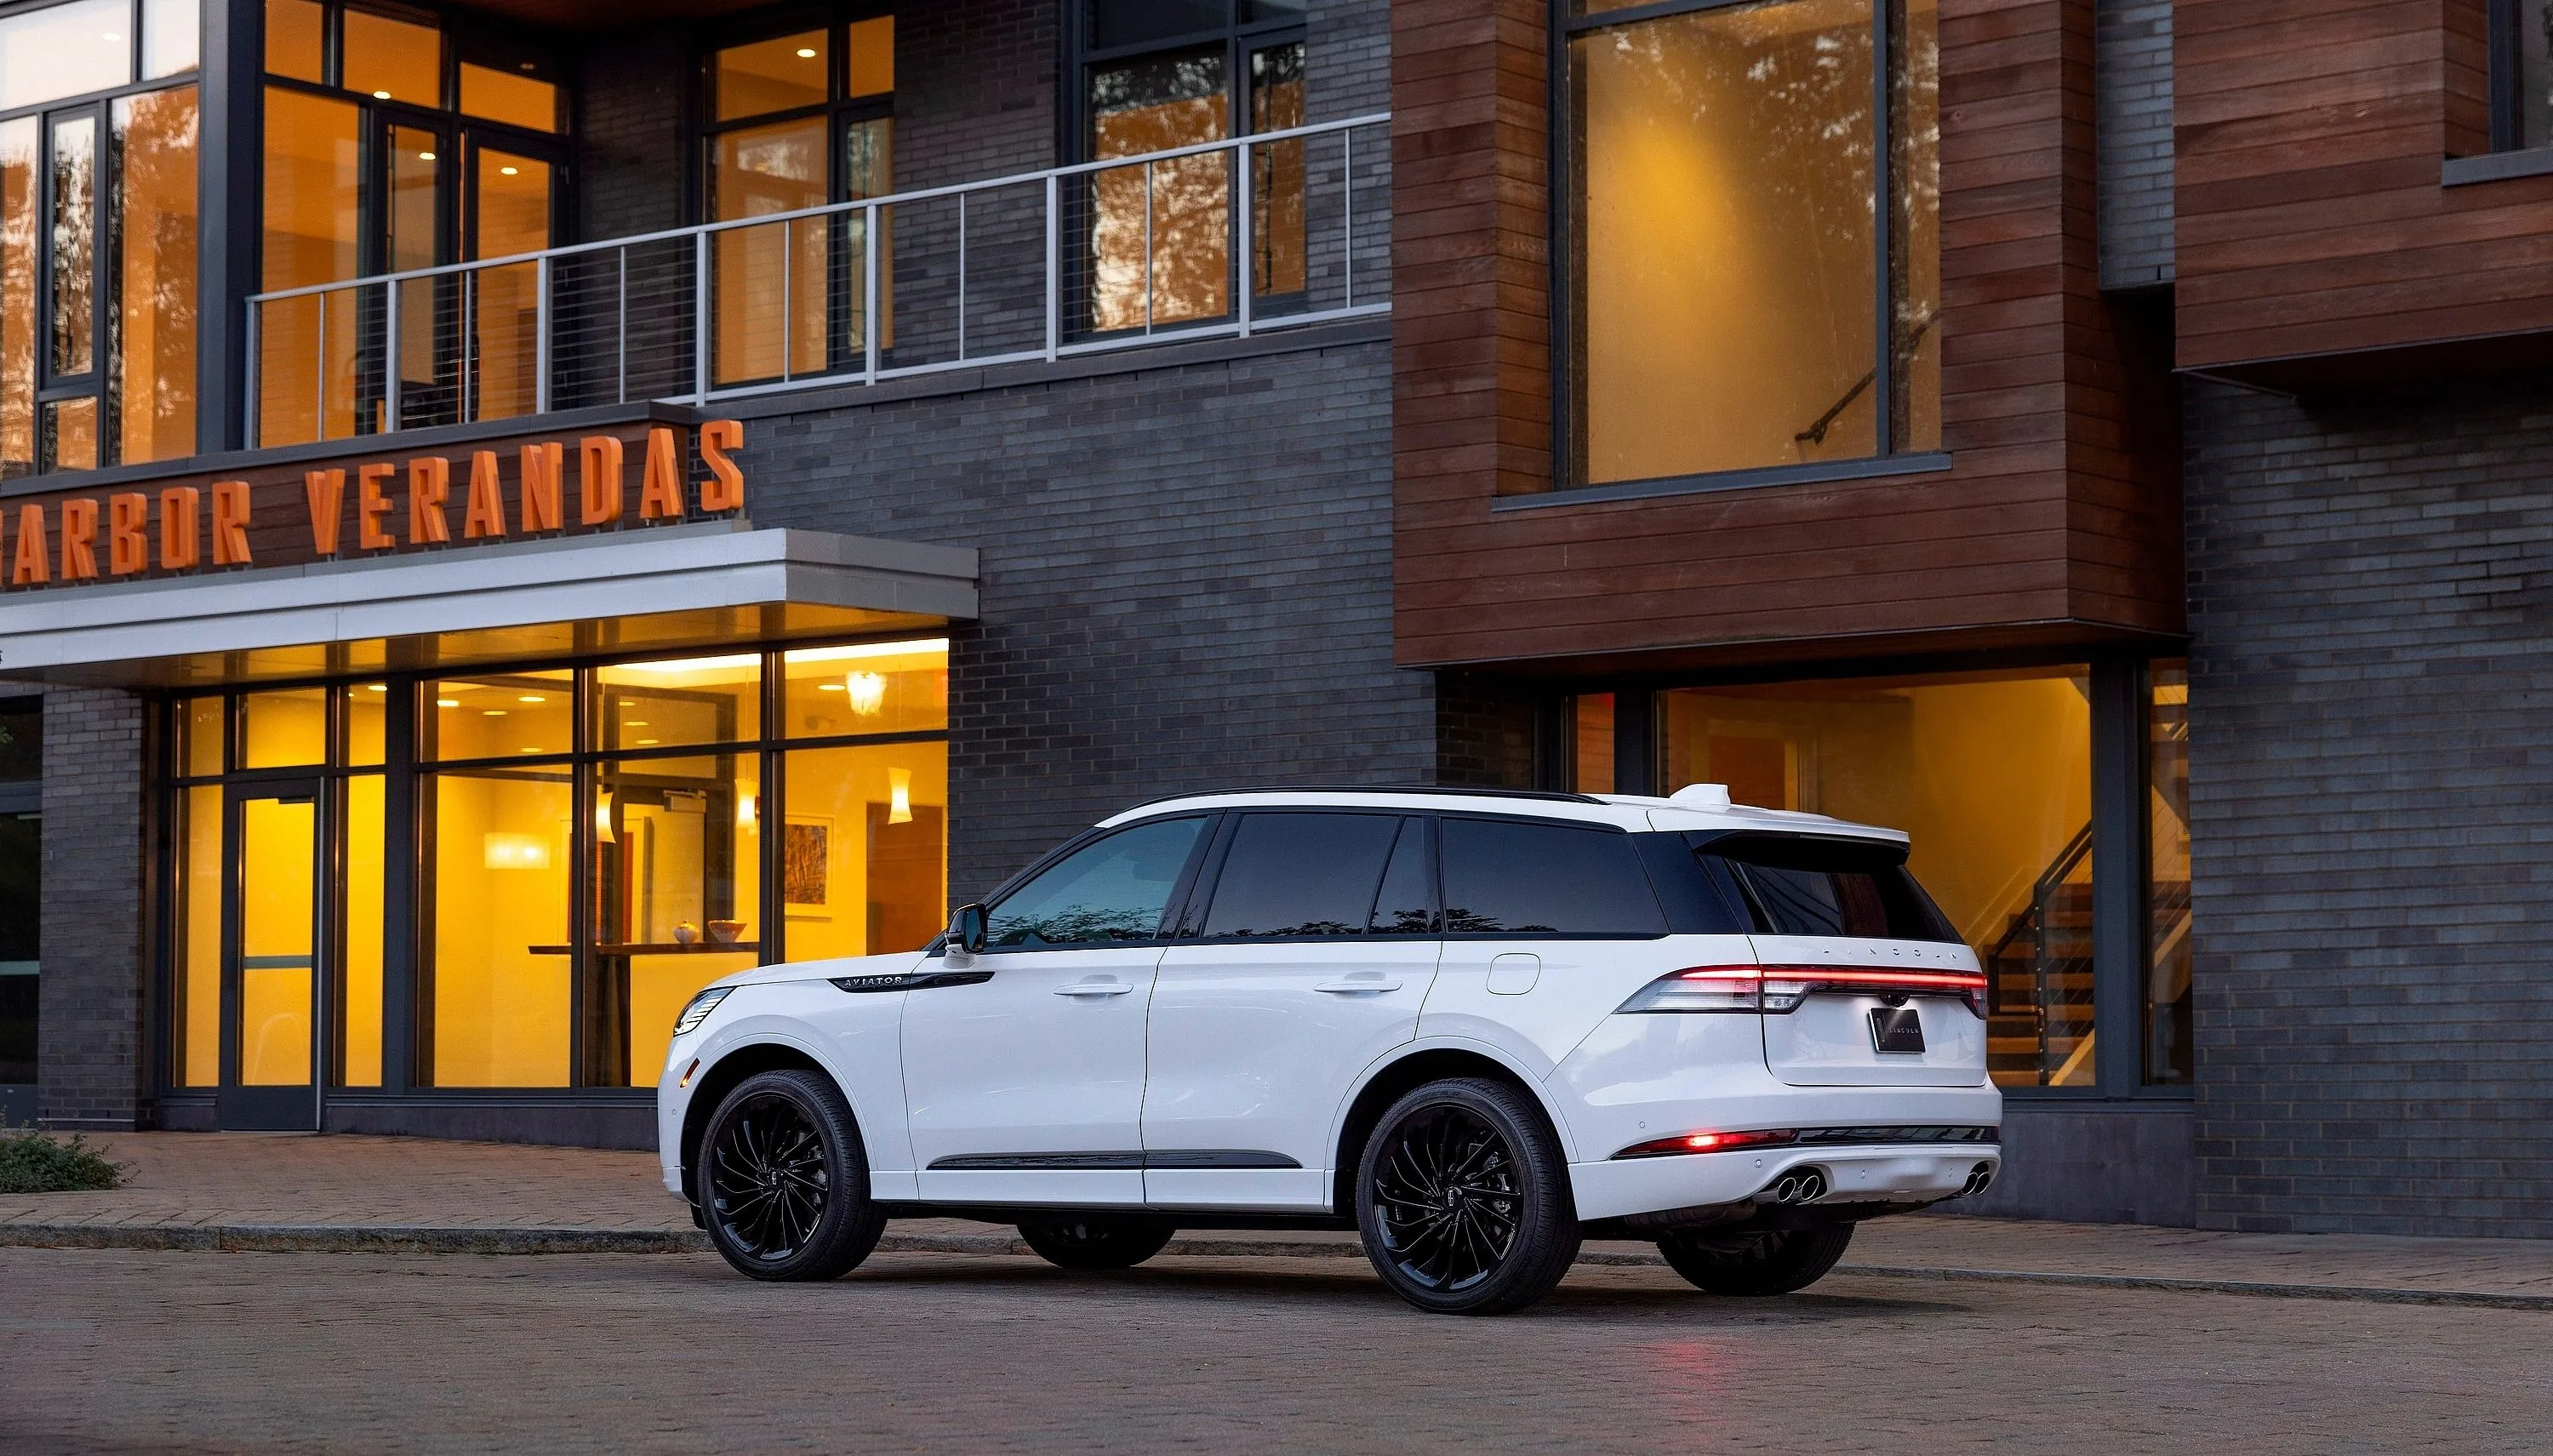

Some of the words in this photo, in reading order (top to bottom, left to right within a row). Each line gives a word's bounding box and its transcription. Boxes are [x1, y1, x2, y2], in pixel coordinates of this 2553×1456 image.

[0, 480, 251, 585] ARBOR
[305, 420, 745, 555] VERANDAS
[844, 976, 903, 987] AVIATOR
